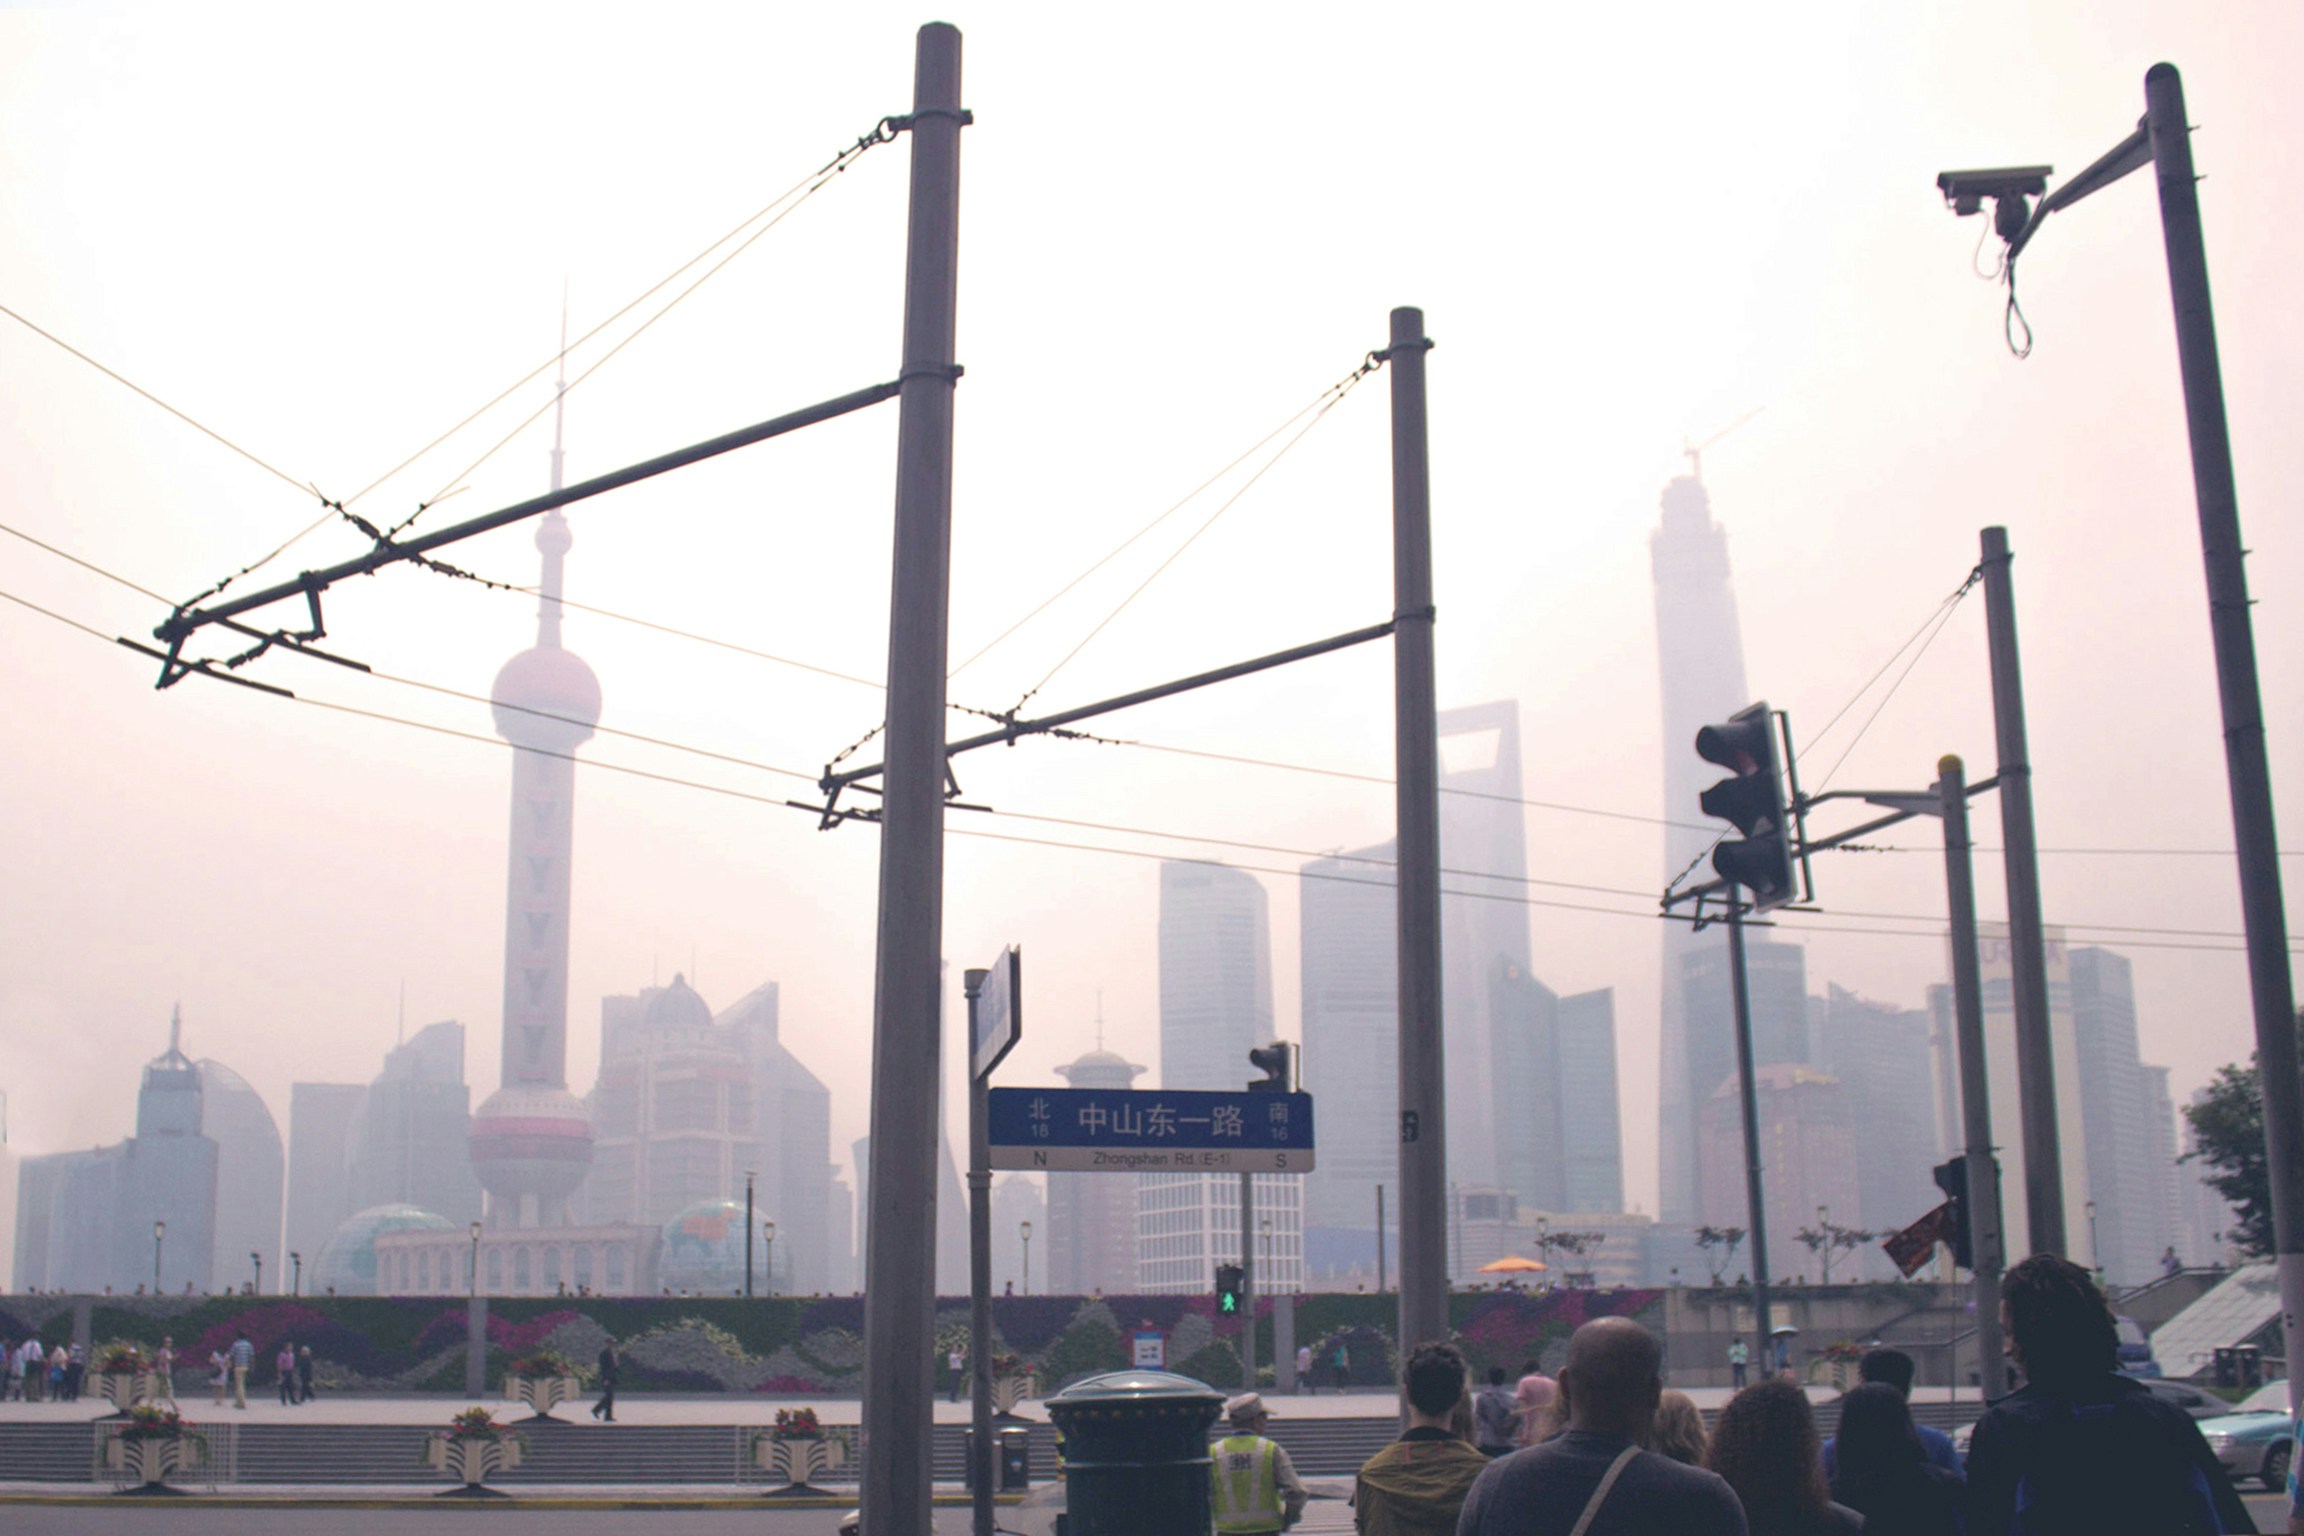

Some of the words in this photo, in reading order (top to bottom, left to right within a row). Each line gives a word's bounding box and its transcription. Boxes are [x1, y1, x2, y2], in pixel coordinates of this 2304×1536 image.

[1029, 1097, 1050, 1120] 北
[1269, 1102, 1289, 1124] 南
[1079, 1102, 1244, 1138] 中山东一路
[1032, 1124, 1049, 1138] 18
[1271, 1126, 1288, 1141] 16
[1034, 1151, 1047, 1166] N
[1093, 1151, 1168, 1168] Zhongshan
[1276, 1153, 1287, 1168] S
